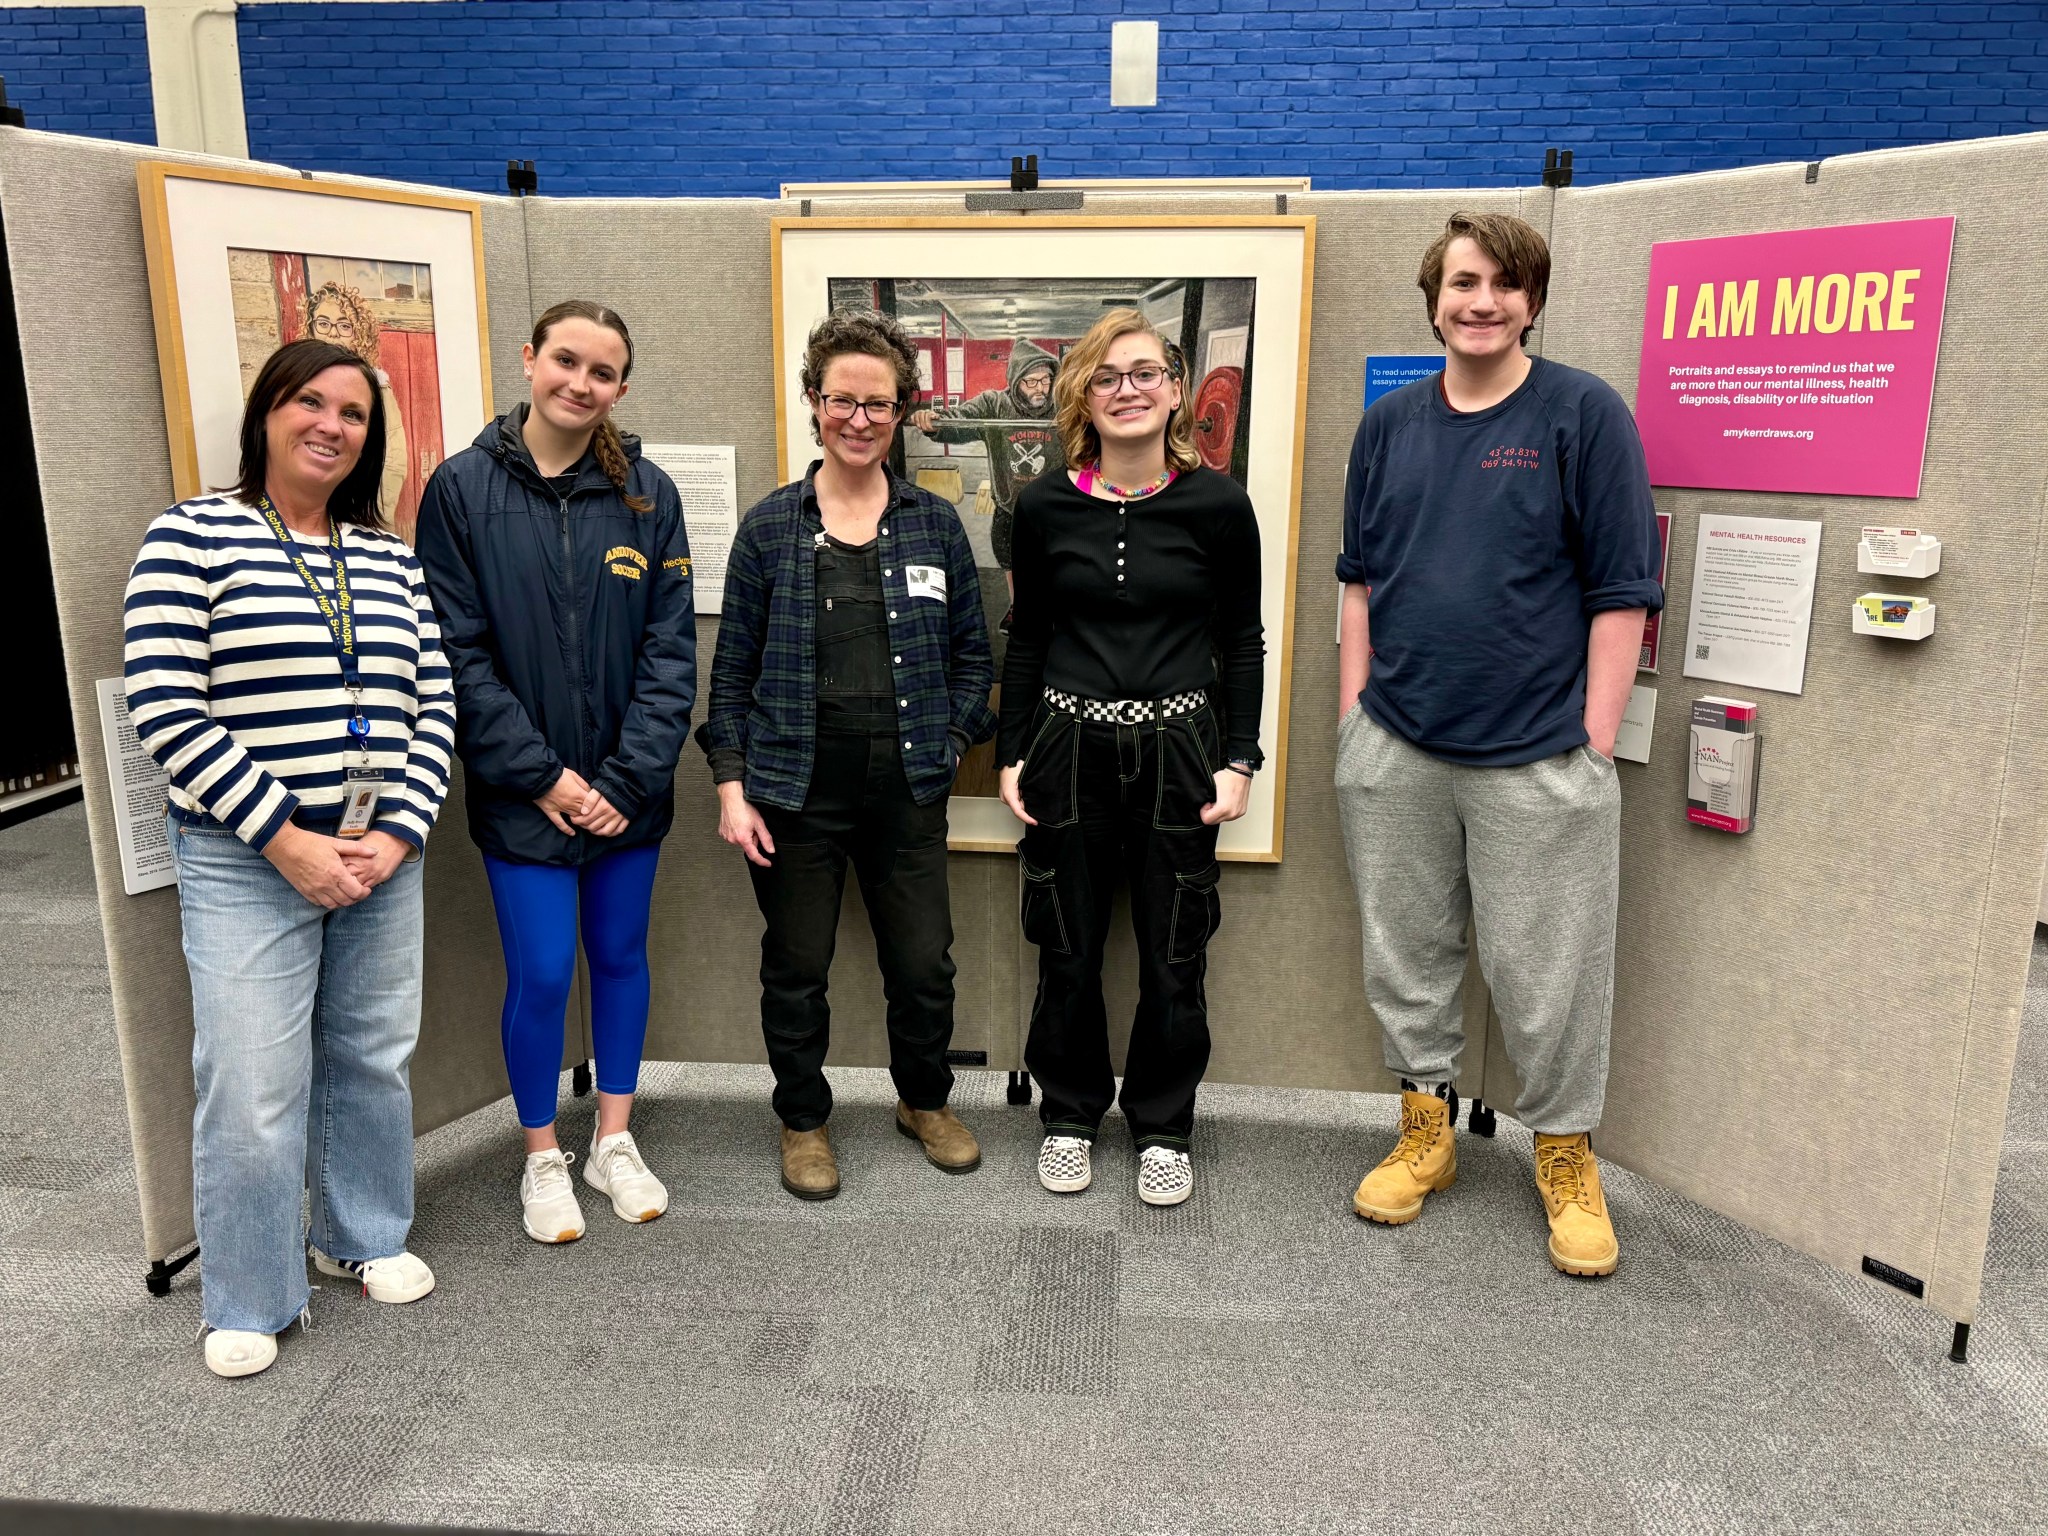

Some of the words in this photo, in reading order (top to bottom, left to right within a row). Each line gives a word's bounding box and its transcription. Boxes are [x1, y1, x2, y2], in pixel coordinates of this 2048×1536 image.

[1662, 285, 1679, 340] I
[1686, 279, 1760, 339] AM
[1770, 268, 1921, 336] MORE
[1372, 368, 1381, 376] To
[1382, 368, 1399, 376] read
[1668, 365, 1713, 376] Portraits
[1714, 364, 1735, 375] and
[1736, 365, 1774, 377] essays
[1775, 364, 1787, 374] to
[1788, 363, 1831, 374] remind
[1832, 364, 1847, 373] us
[1849, 362, 1875, 373] that
[1876, 363, 1895, 373] we
[1372, 379, 1397, 387] essays
[1670, 381, 1687, 390] are
[1688, 381, 1716, 390] more
[1717, 379, 1742, 390] than
[1743, 380, 1763, 390] our
[1764, 378, 1804, 389] mental
[1805, 377, 1847, 390] illness,
[1849, 377, 1889, 388] health
[1679, 394, 1732, 407] diagnosis,
[1733, 393, 1784, 406] disability
[1785, 395, 1799, 404] or
[1800, 393, 1819, 404] life
[1820, 393, 1874, 404] situation
[1723, 428, 1814, 441] amykerrdraws.org
[265, 510, 291, 542] School
[1709, 530, 1736, 539] MENTAL
[1736, 533, 1763, 541] HEALTH
[1764, 535, 1807, 545] RESOURCES
[604, 546, 648, 571] ANDOVER
[333, 559, 347, 592] School
[611, 563, 641, 580] SOCCER
[680, 565, 689, 576] 3
[292, 557, 322, 594] Andover
[317, 595, 335, 618] High
[340, 591, 352, 611] High
[342, 612, 354, 655] Andover
